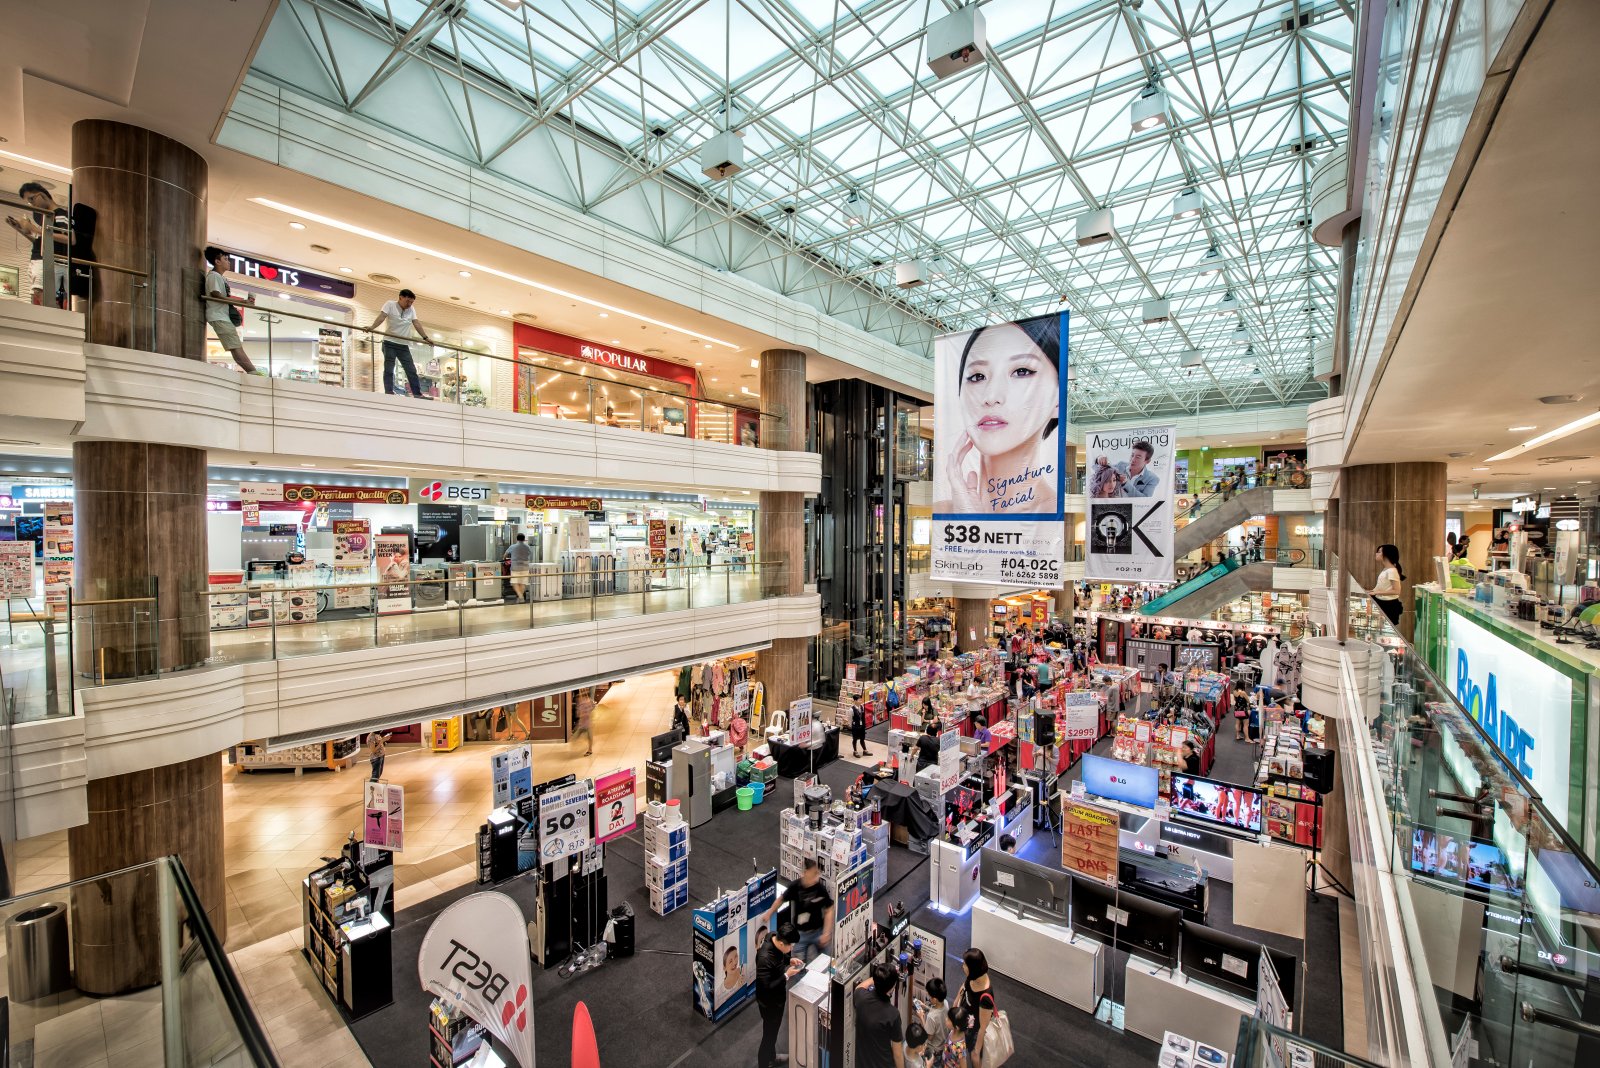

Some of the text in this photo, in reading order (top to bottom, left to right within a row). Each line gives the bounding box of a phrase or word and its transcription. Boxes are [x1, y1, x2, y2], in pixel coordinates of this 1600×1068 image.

[593, 348, 648, 373] POPULAR
[987, 464, 1054, 496] Signature
[25, 487, 74, 498] SAMSUN
[314, 490, 388, 502] Premium Quality
[448, 486, 491, 499] BEST
[990, 487, 1034, 511] Facial
[545, 499, 568, 507] Premium
[349, 536, 362, 544] $10
[943, 523, 1022, 544] $38 NETT
[963, 547, 988, 555] Hydration
[934, 558, 1059, 571] SkinLab #04-02C
[1038, 572, 1059, 580] 5898
[1068, 728, 1095, 737] $2999
[562, 787, 587, 799] KUVINGS
[601, 788, 631, 804] ROADSHOW
[607, 784, 625, 795] ATRIUM
[541, 794, 561, 806] BRAUN
[565, 793, 587, 806] SEVERIN
[611, 800, 623, 821] 2
[546, 808, 587, 836] 50%
[609, 817, 626, 831] DAY
[1084, 811, 1118, 825] ROADSHOW
[1069, 822, 1102, 837] LAST
[1186, 831, 1201, 839] HDTV
[1084, 842, 1092, 854] 2
[1144, 844, 1155, 852] LG
[1076, 858, 1108, 872] DAYS
[838, 876, 858, 894] dyson
[695, 915, 713, 932] Oral-B
[892, 918, 908, 936] dyson
[912, 931, 929, 943] dyson
